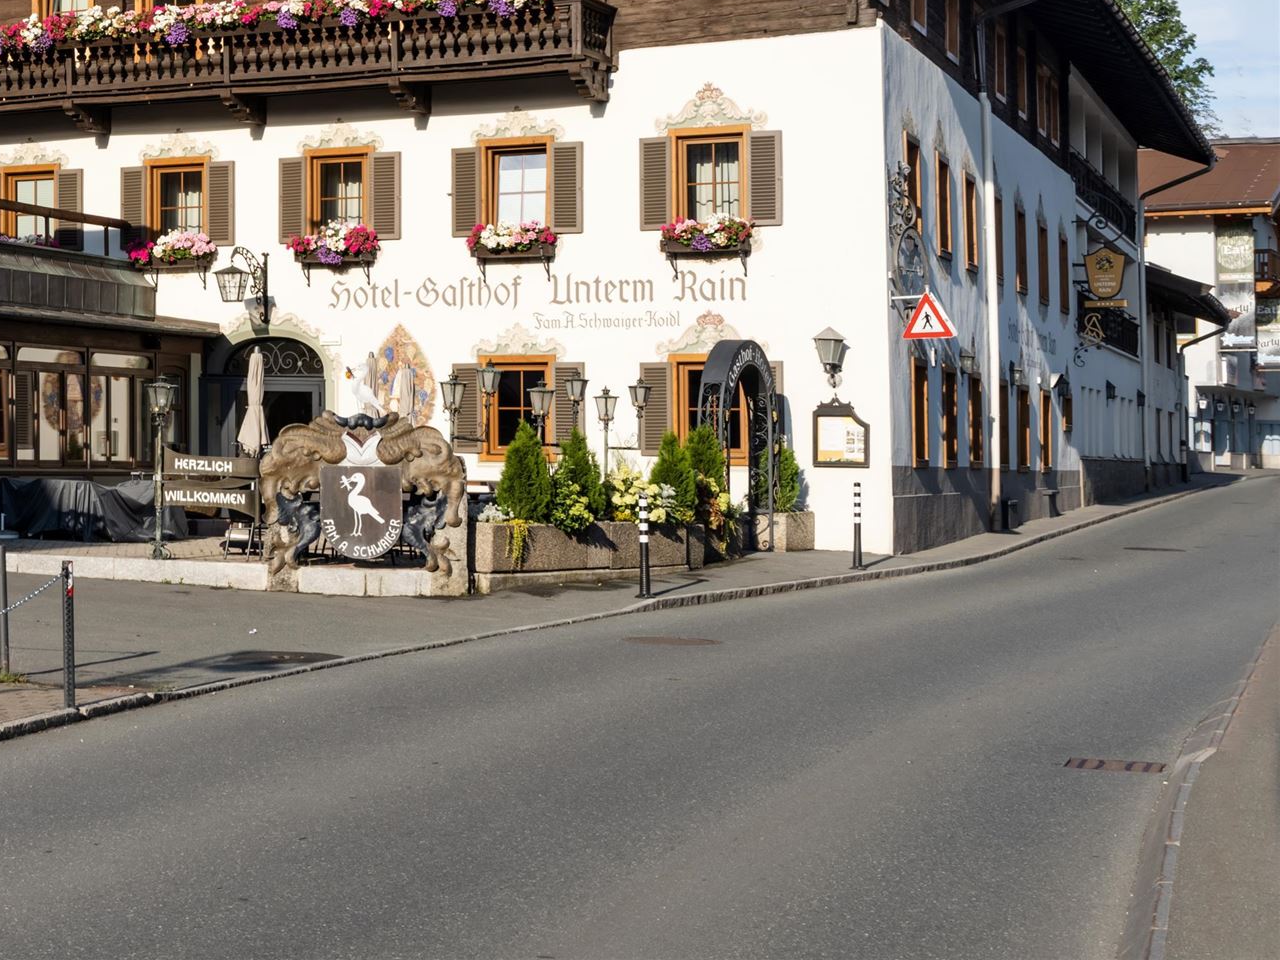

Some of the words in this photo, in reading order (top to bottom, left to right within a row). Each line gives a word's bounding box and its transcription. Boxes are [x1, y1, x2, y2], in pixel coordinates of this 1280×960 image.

[549, 273, 654, 305] Unterm
[672, 270, 746, 302] Rain
[175, 458, 233, 473] HERZLICH
[164, 490, 246, 505] WILLKOMMEN
[353, 519, 401, 557] SCHWAIGER
